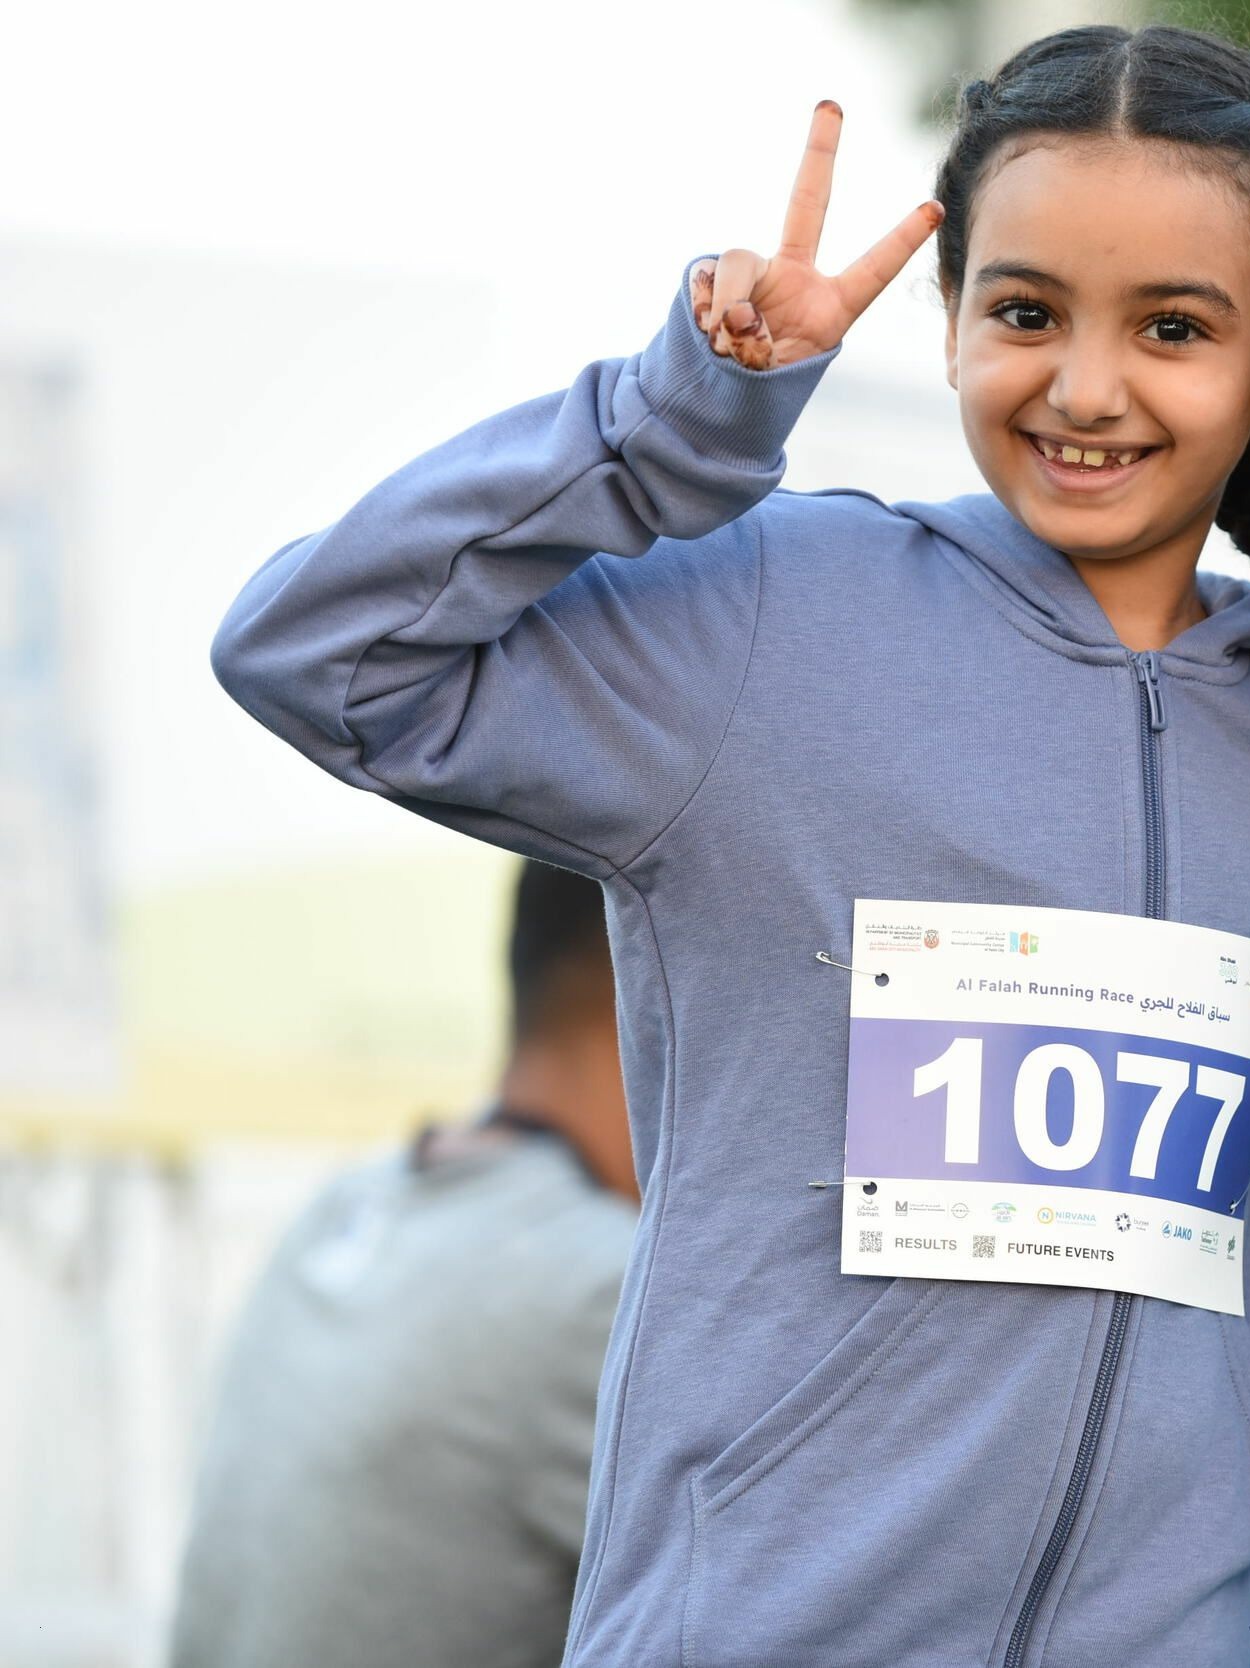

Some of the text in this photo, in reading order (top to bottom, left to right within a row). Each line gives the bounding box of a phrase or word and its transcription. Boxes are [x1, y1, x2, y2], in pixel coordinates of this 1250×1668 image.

[956, 978, 1135, 1003] Al Falah Running Race
[1139, 997, 1231, 1022] سباق الفلاح للجري
[912, 1037, 1247, 1193] 1077
[1055, 1211, 1097, 1223] NIRVANA
[1173, 1225, 1193, 1241] JAKO
[894, 1237, 958, 1251] RESULTS
[1007, 1242, 1115, 1262] FUTURE EVENTS
